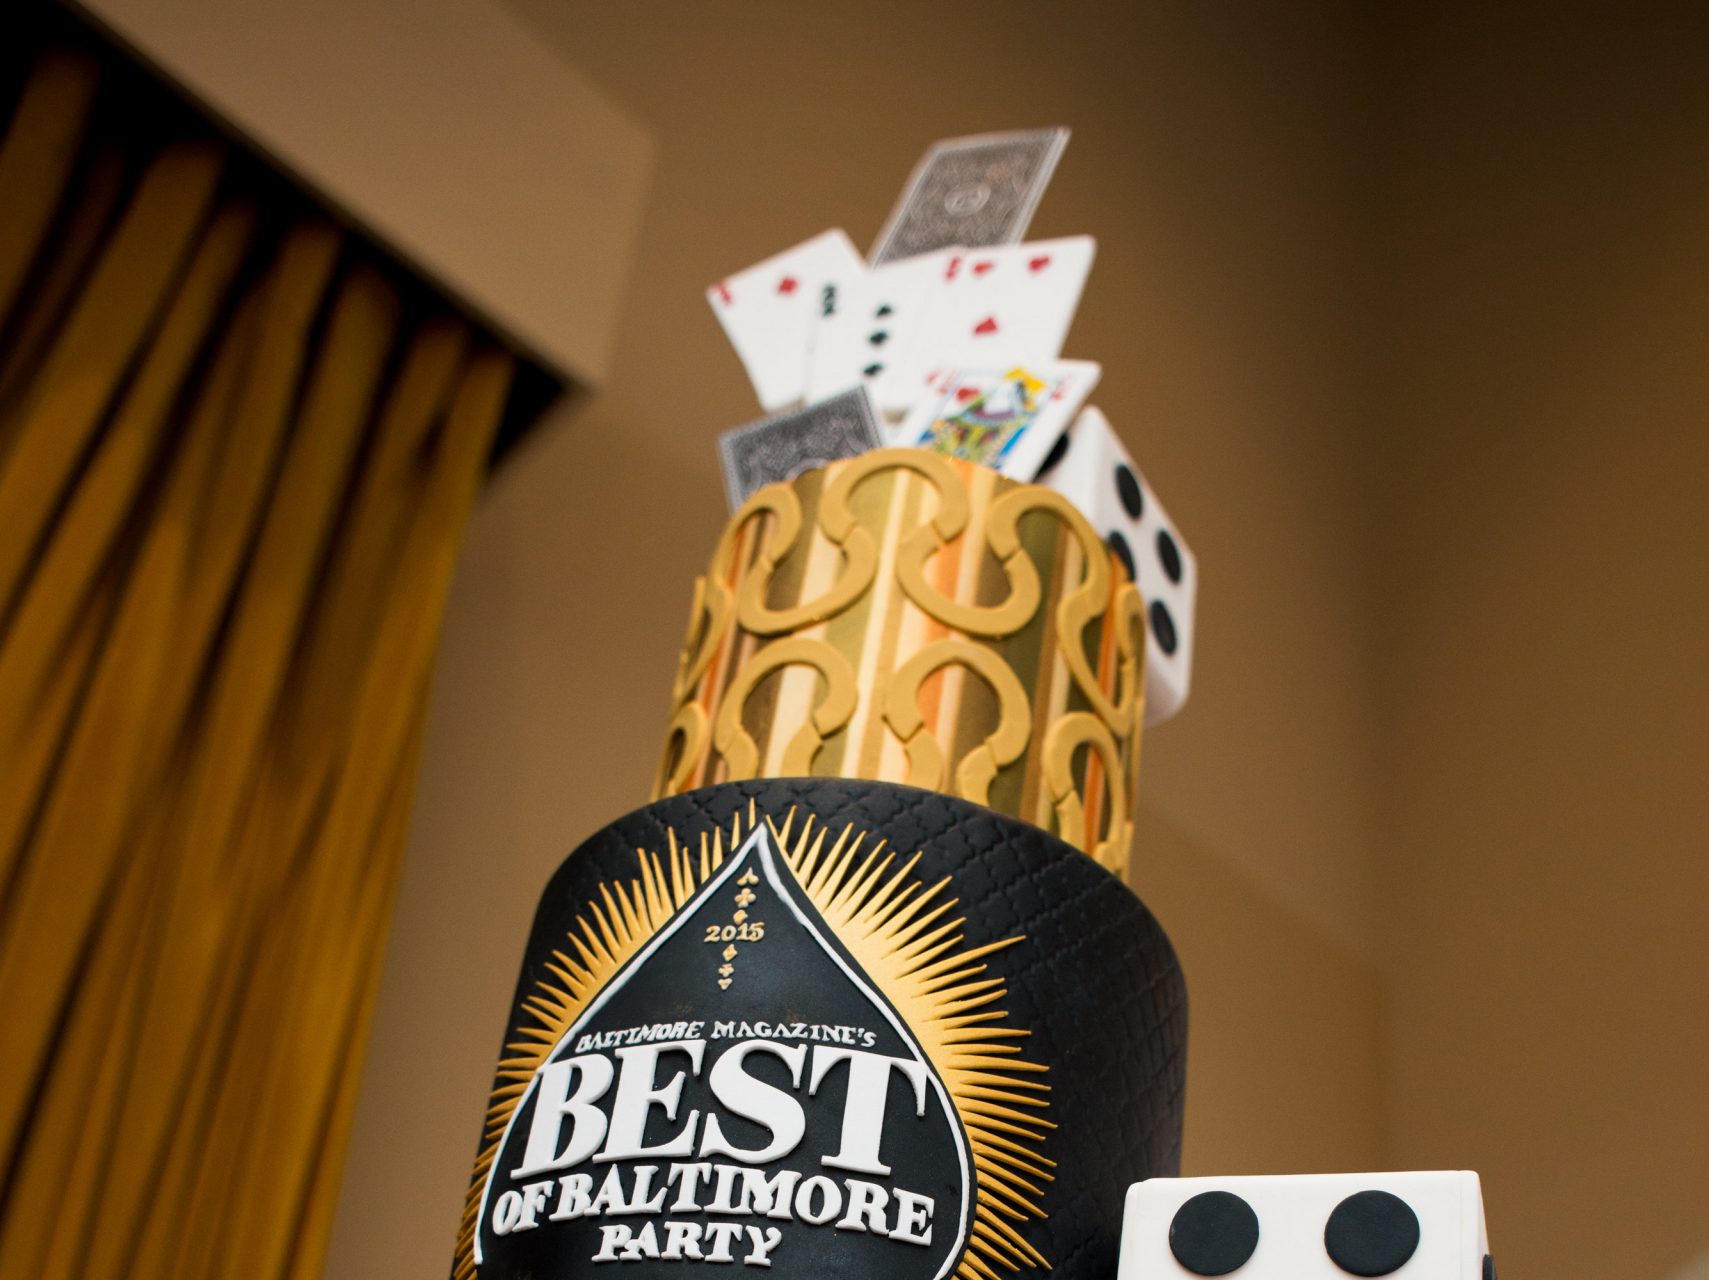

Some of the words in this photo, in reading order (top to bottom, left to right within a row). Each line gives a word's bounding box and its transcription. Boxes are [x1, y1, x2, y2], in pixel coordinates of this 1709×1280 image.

[703, 921, 765, 942] 2015
[575, 1021, 705, 1053] BALTIMORE
[711, 1020, 877, 1048] MAGAZINE'S
[510, 1040, 930, 1180] BEST
[492, 1179, 554, 1236] OF
[549, 1162, 935, 1246] BALTIMORE
[592, 1221, 782, 1266] PARTY
